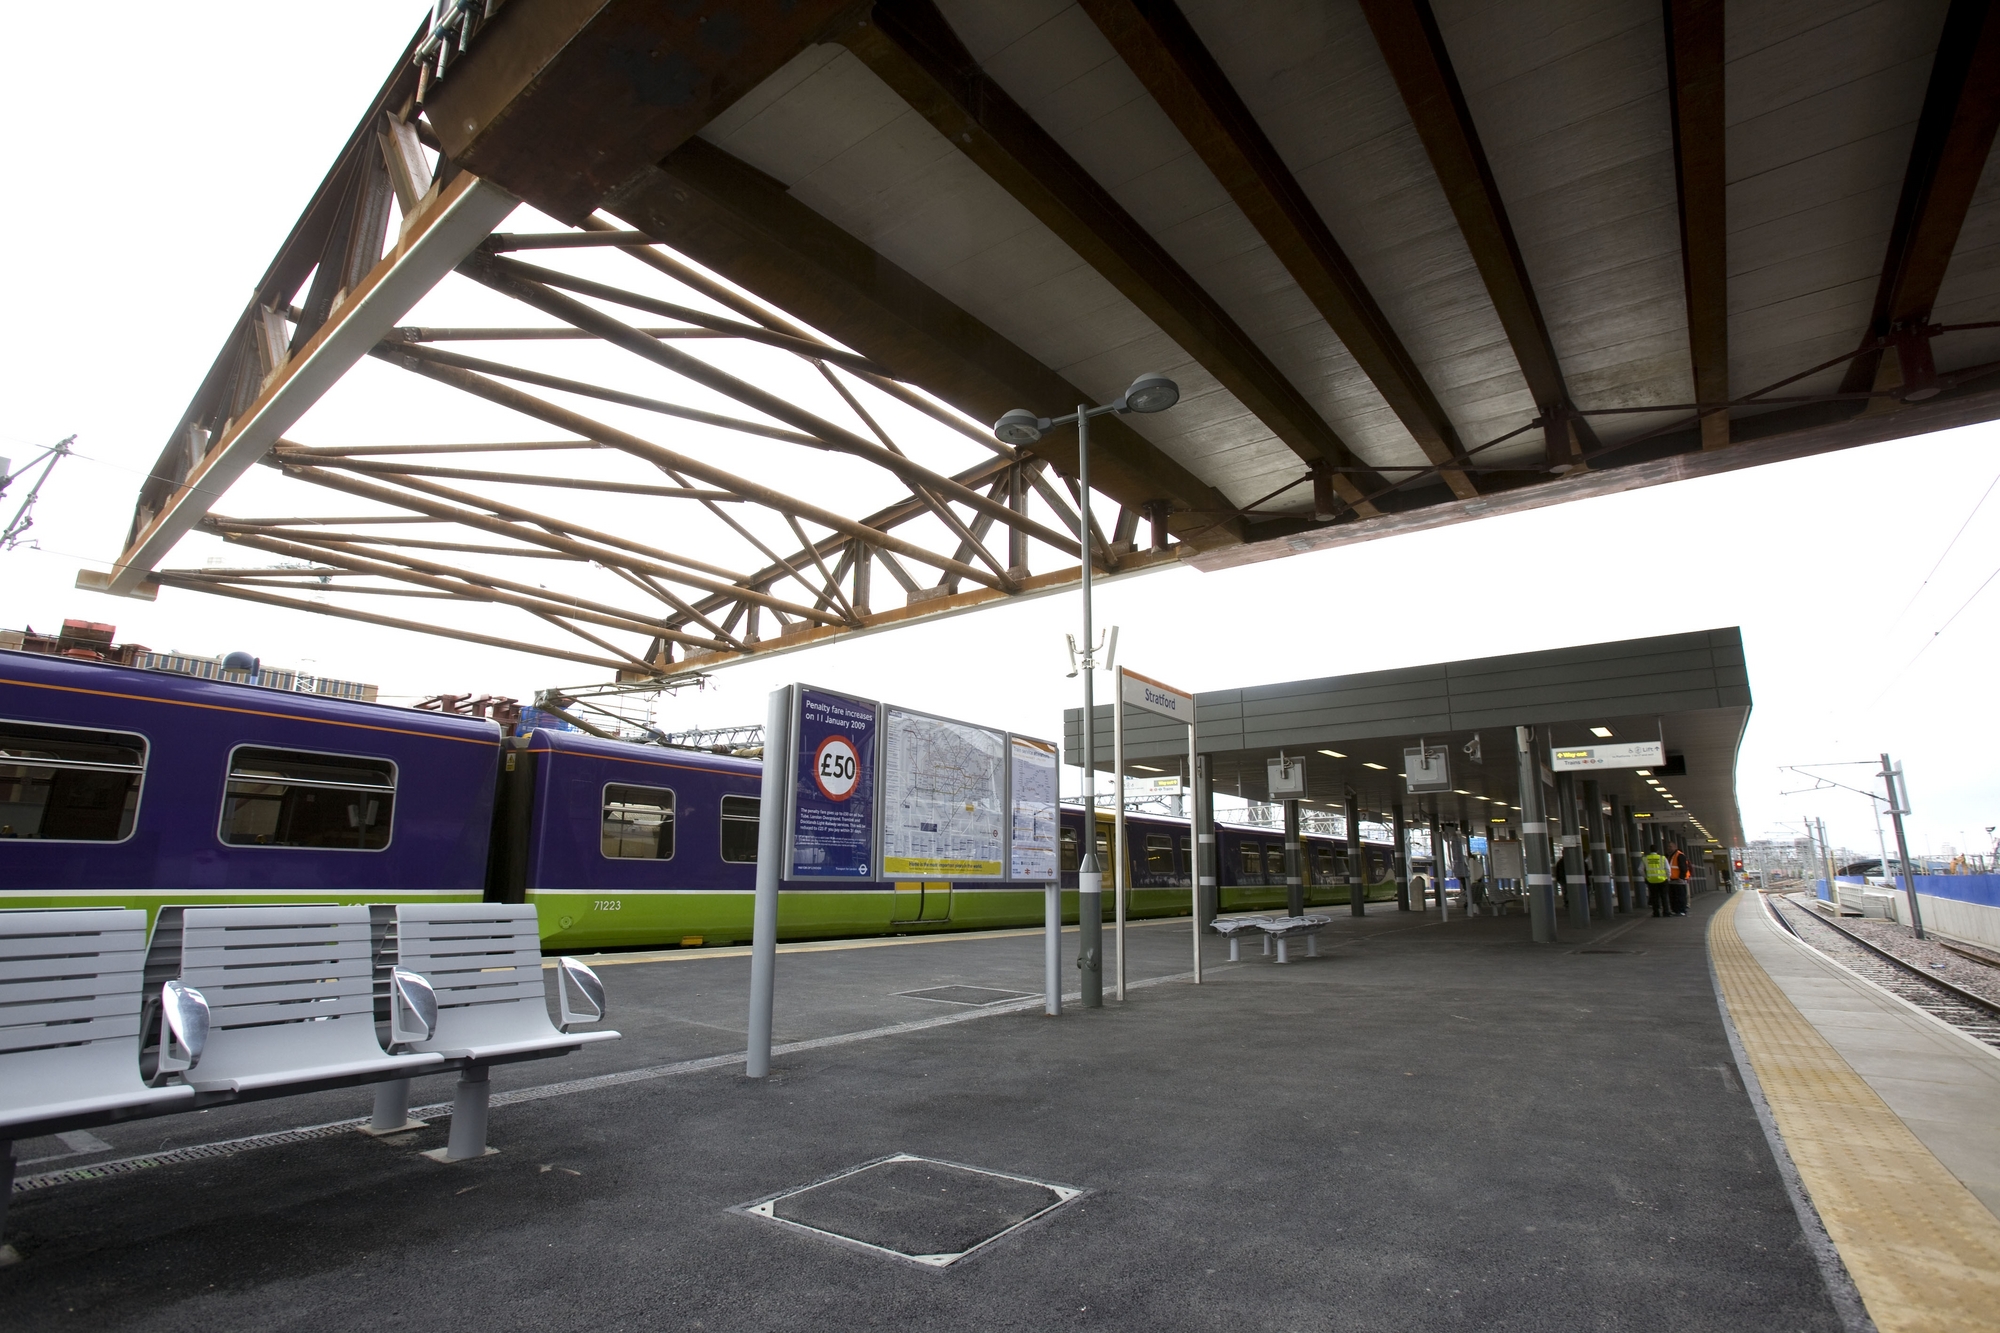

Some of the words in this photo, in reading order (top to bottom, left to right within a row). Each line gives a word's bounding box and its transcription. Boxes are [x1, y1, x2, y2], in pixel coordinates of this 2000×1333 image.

[1144, 688, 1176, 710] Stratford
[806, 700, 830, 714] Penalty
[832, 705, 844, 716] fare
[844, 708, 873, 721] increases
[816, 714, 823, 722] 11
[825, 716, 849, 728] January
[851, 720, 866, 730] 2009
[821, 753, 855, 780] £50
[594, 900, 621, 910] 71223
